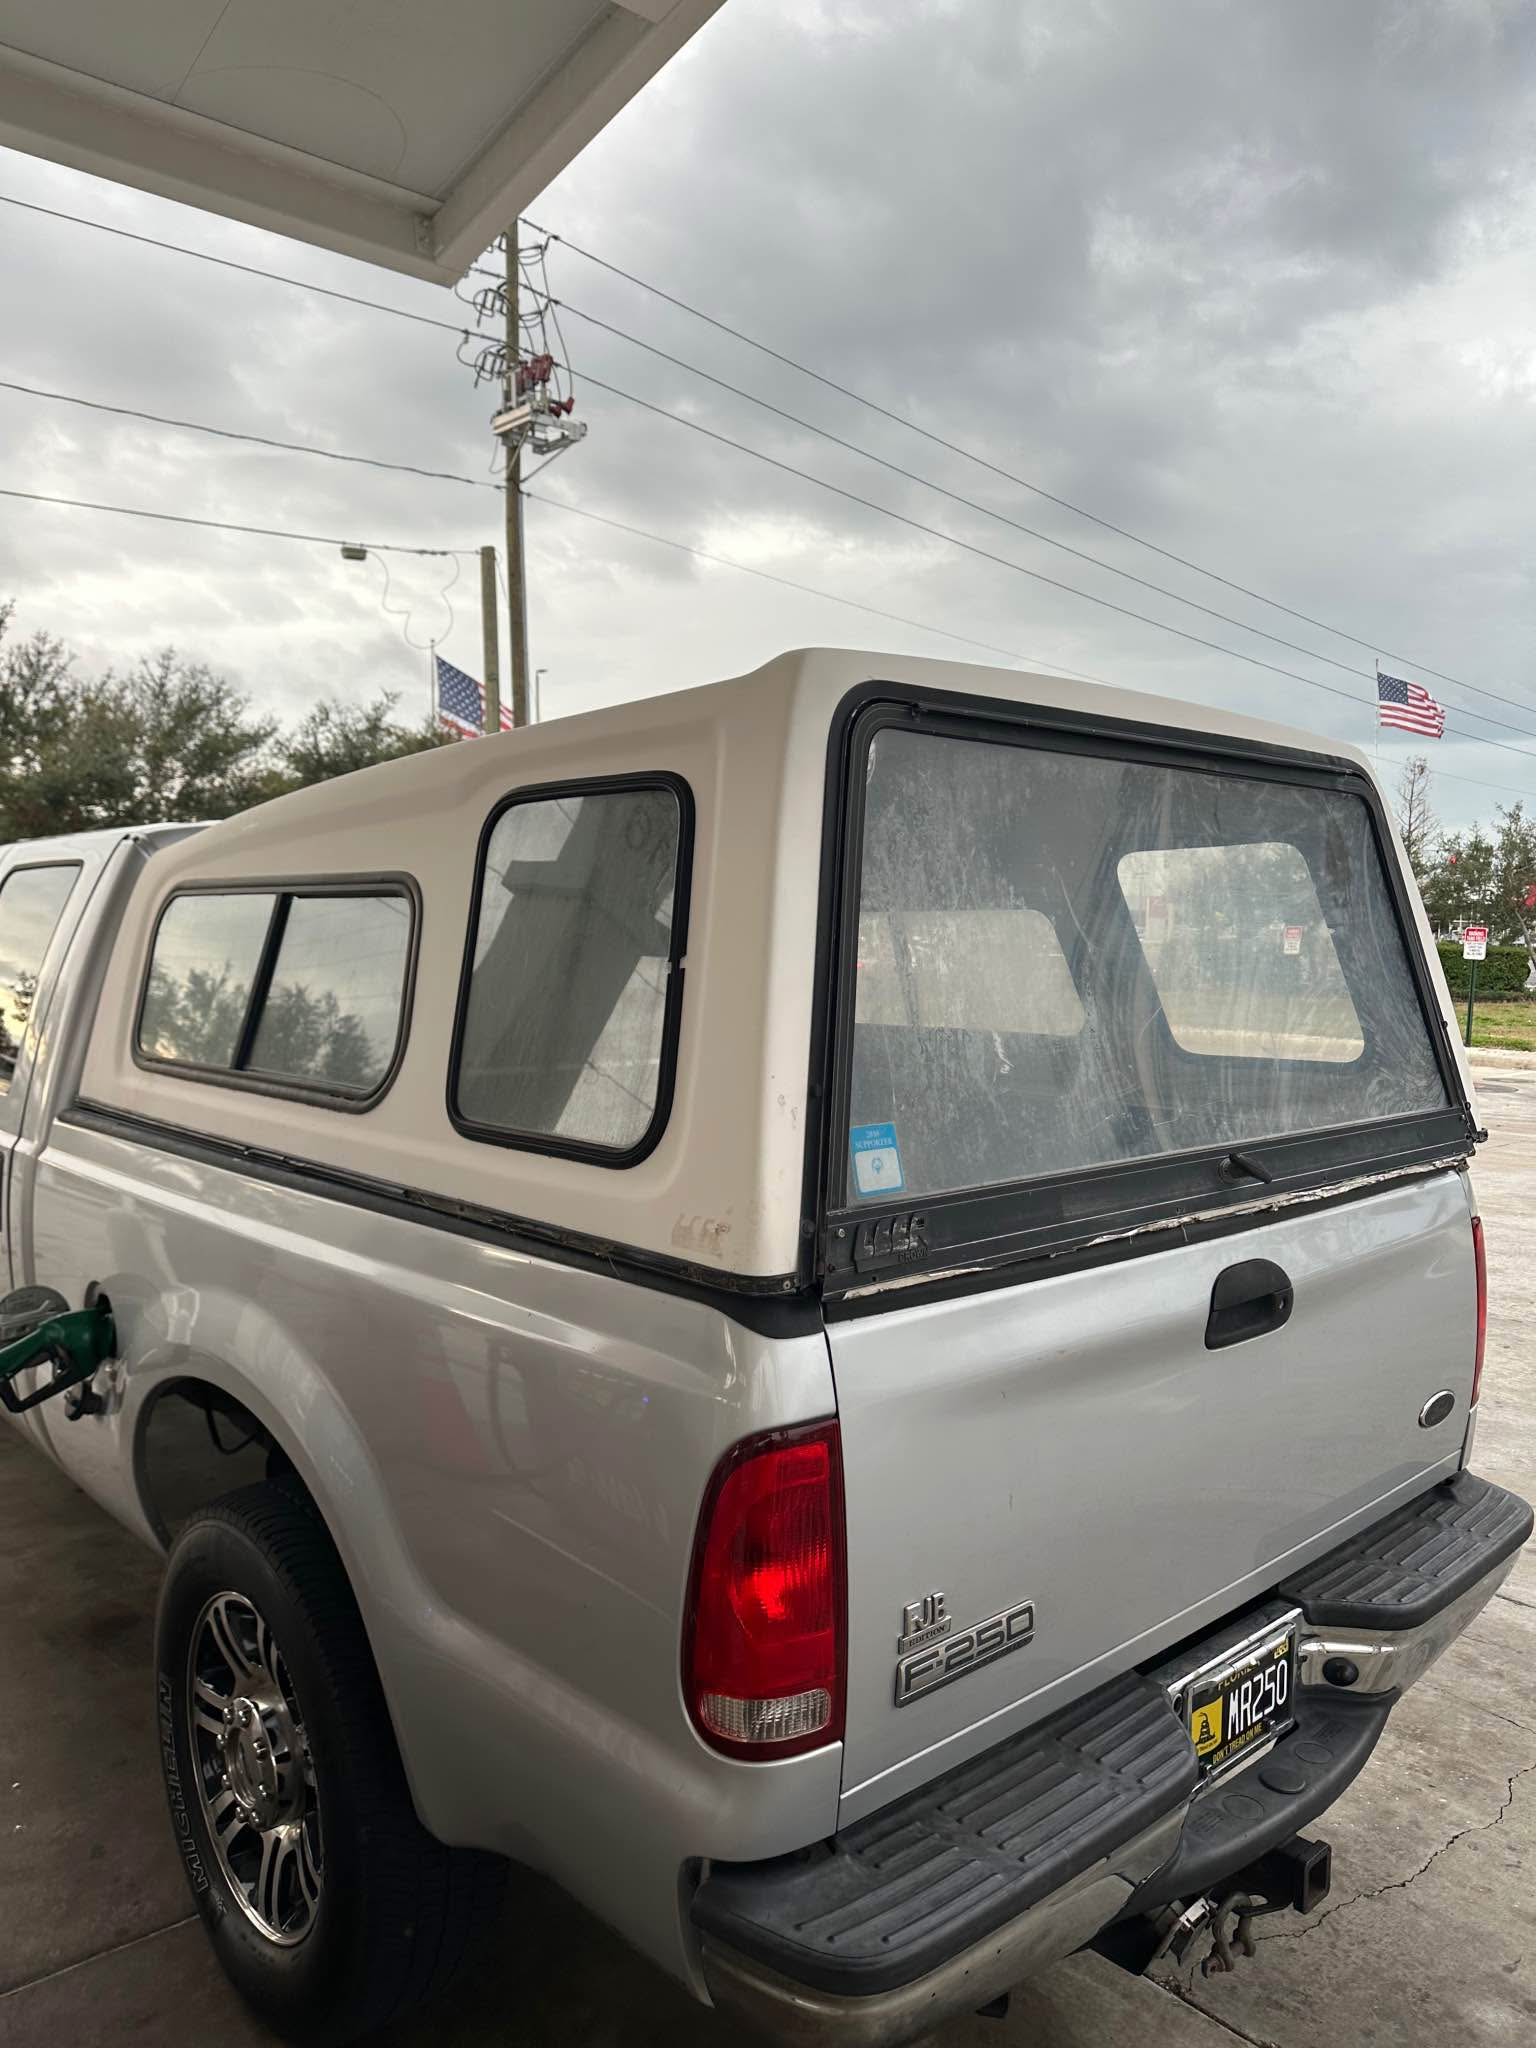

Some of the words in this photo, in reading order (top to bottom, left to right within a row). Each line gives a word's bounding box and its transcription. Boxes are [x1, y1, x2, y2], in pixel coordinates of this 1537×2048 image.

[1227, 1659, 1288, 1740] MR250
[1229, 1735, 1246, 1754] TREAD
[1245, 1727, 1254, 1745] ON
[1253, 1721, 1263, 1739] ME
[158, 1671, 209, 1893] MICHELIN
